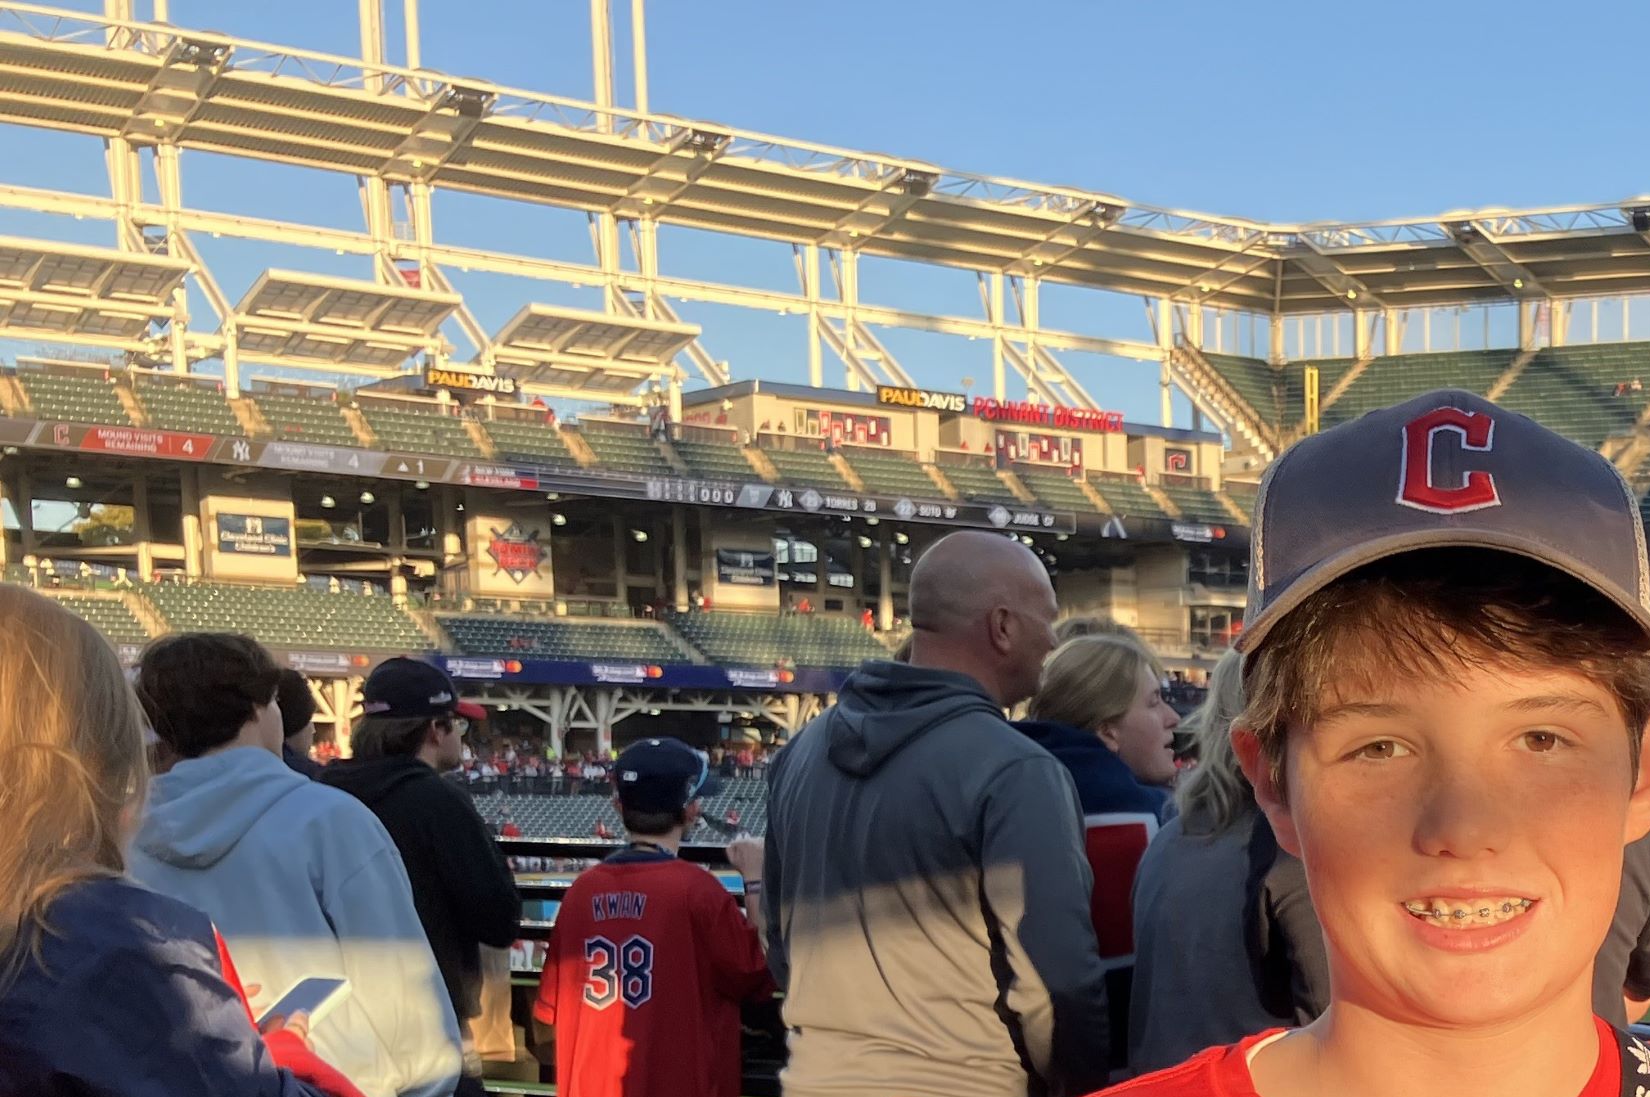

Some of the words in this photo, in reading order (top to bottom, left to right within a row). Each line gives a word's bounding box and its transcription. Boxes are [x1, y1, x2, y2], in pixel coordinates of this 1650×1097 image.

[973, 397, 1049, 426] PENNANT
[1054, 404, 1123, 432] DISTRICT
[98, 429, 132, 442] MOUND
[133, 432, 163, 444] VISITS
[104, 440, 157, 453] REMAINING
[182, 439, 194, 455] 4
[348, 453, 359, 469] 4
[1395, 406, 1502, 515] C
[592, 891, 647, 922] KWAN
[583, 934, 654, 1011] 38
